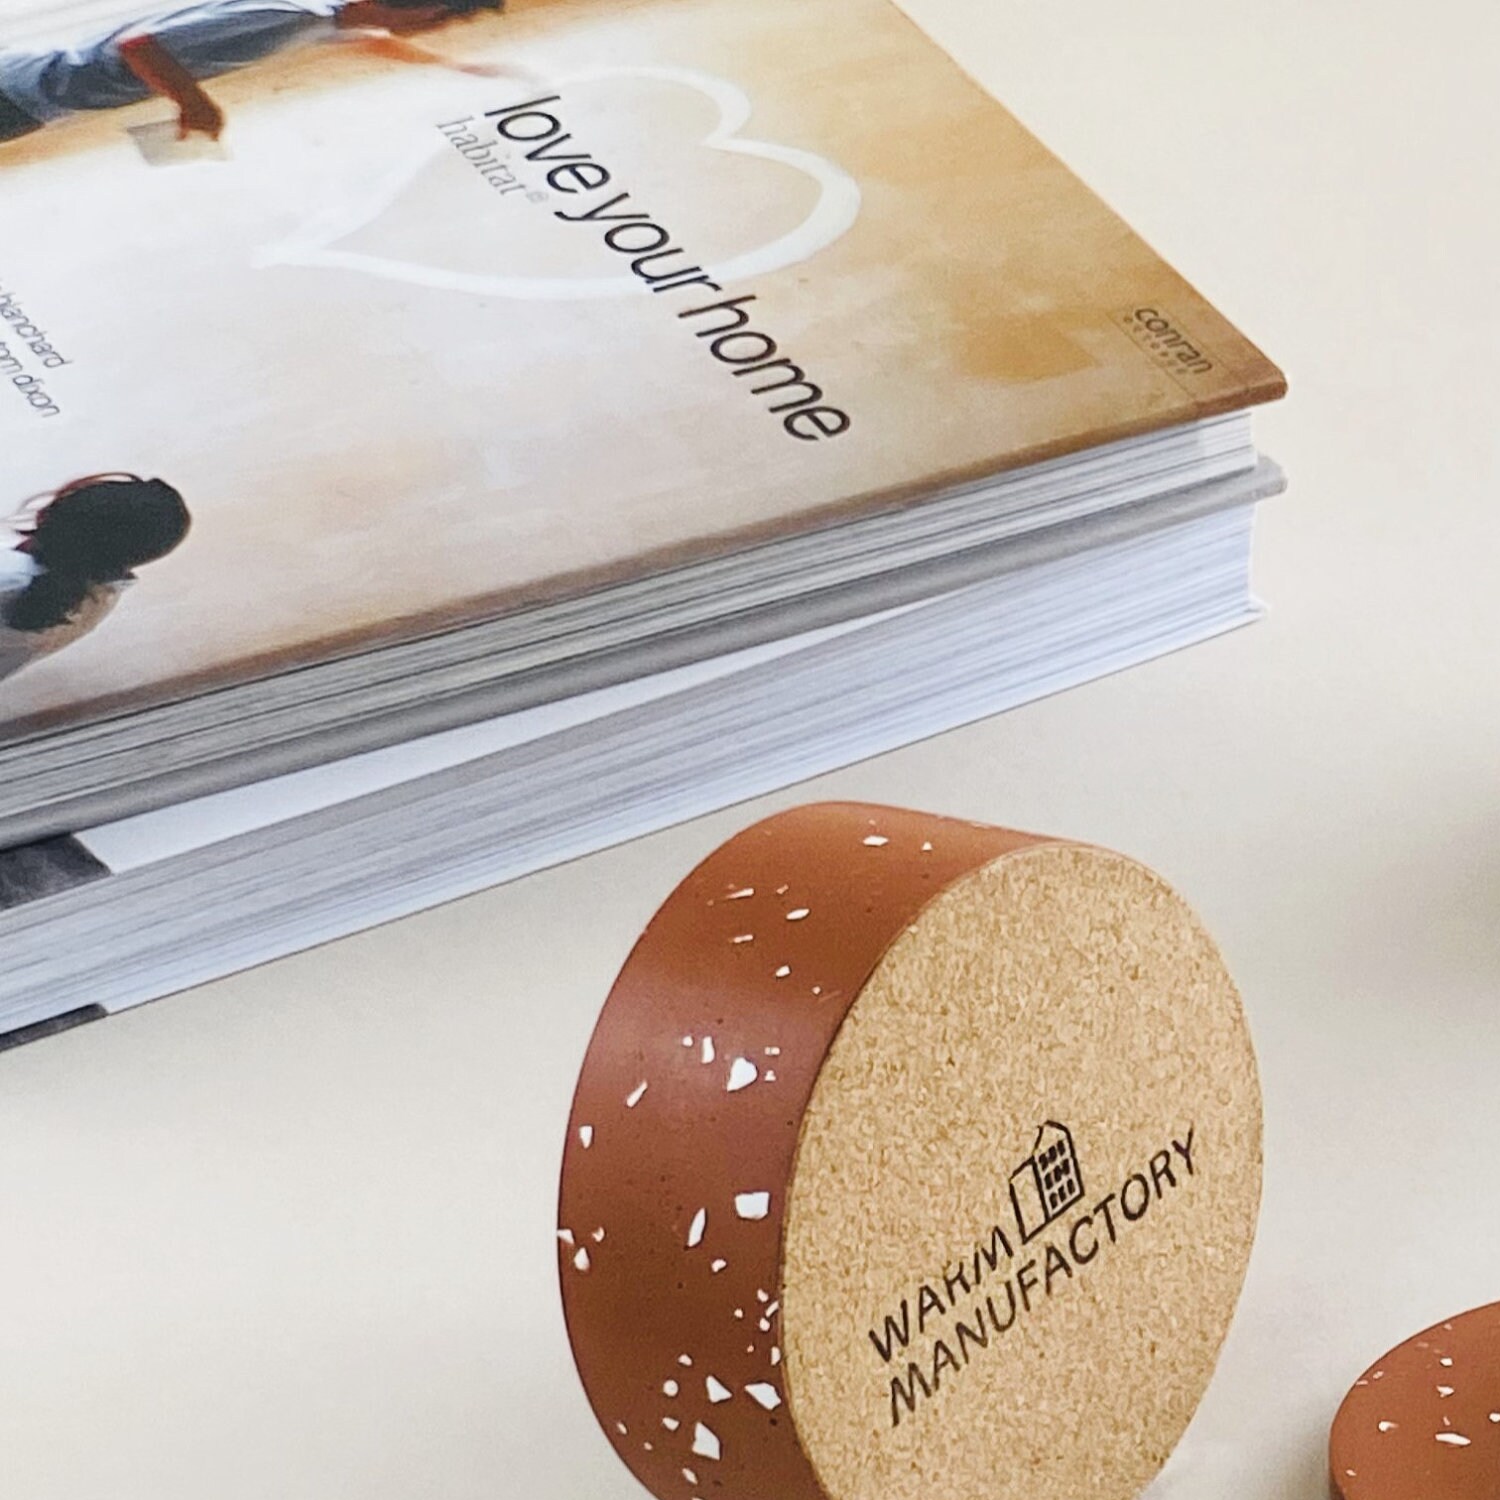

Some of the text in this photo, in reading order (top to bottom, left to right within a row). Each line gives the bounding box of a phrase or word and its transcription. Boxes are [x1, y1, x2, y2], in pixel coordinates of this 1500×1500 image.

[484, 95, 851, 441] love your home
[1135, 308, 1213, 374] conran
[868, 1225, 1013, 1363] WARM
[890, 1126, 1195, 1428] MANUFACTORY
